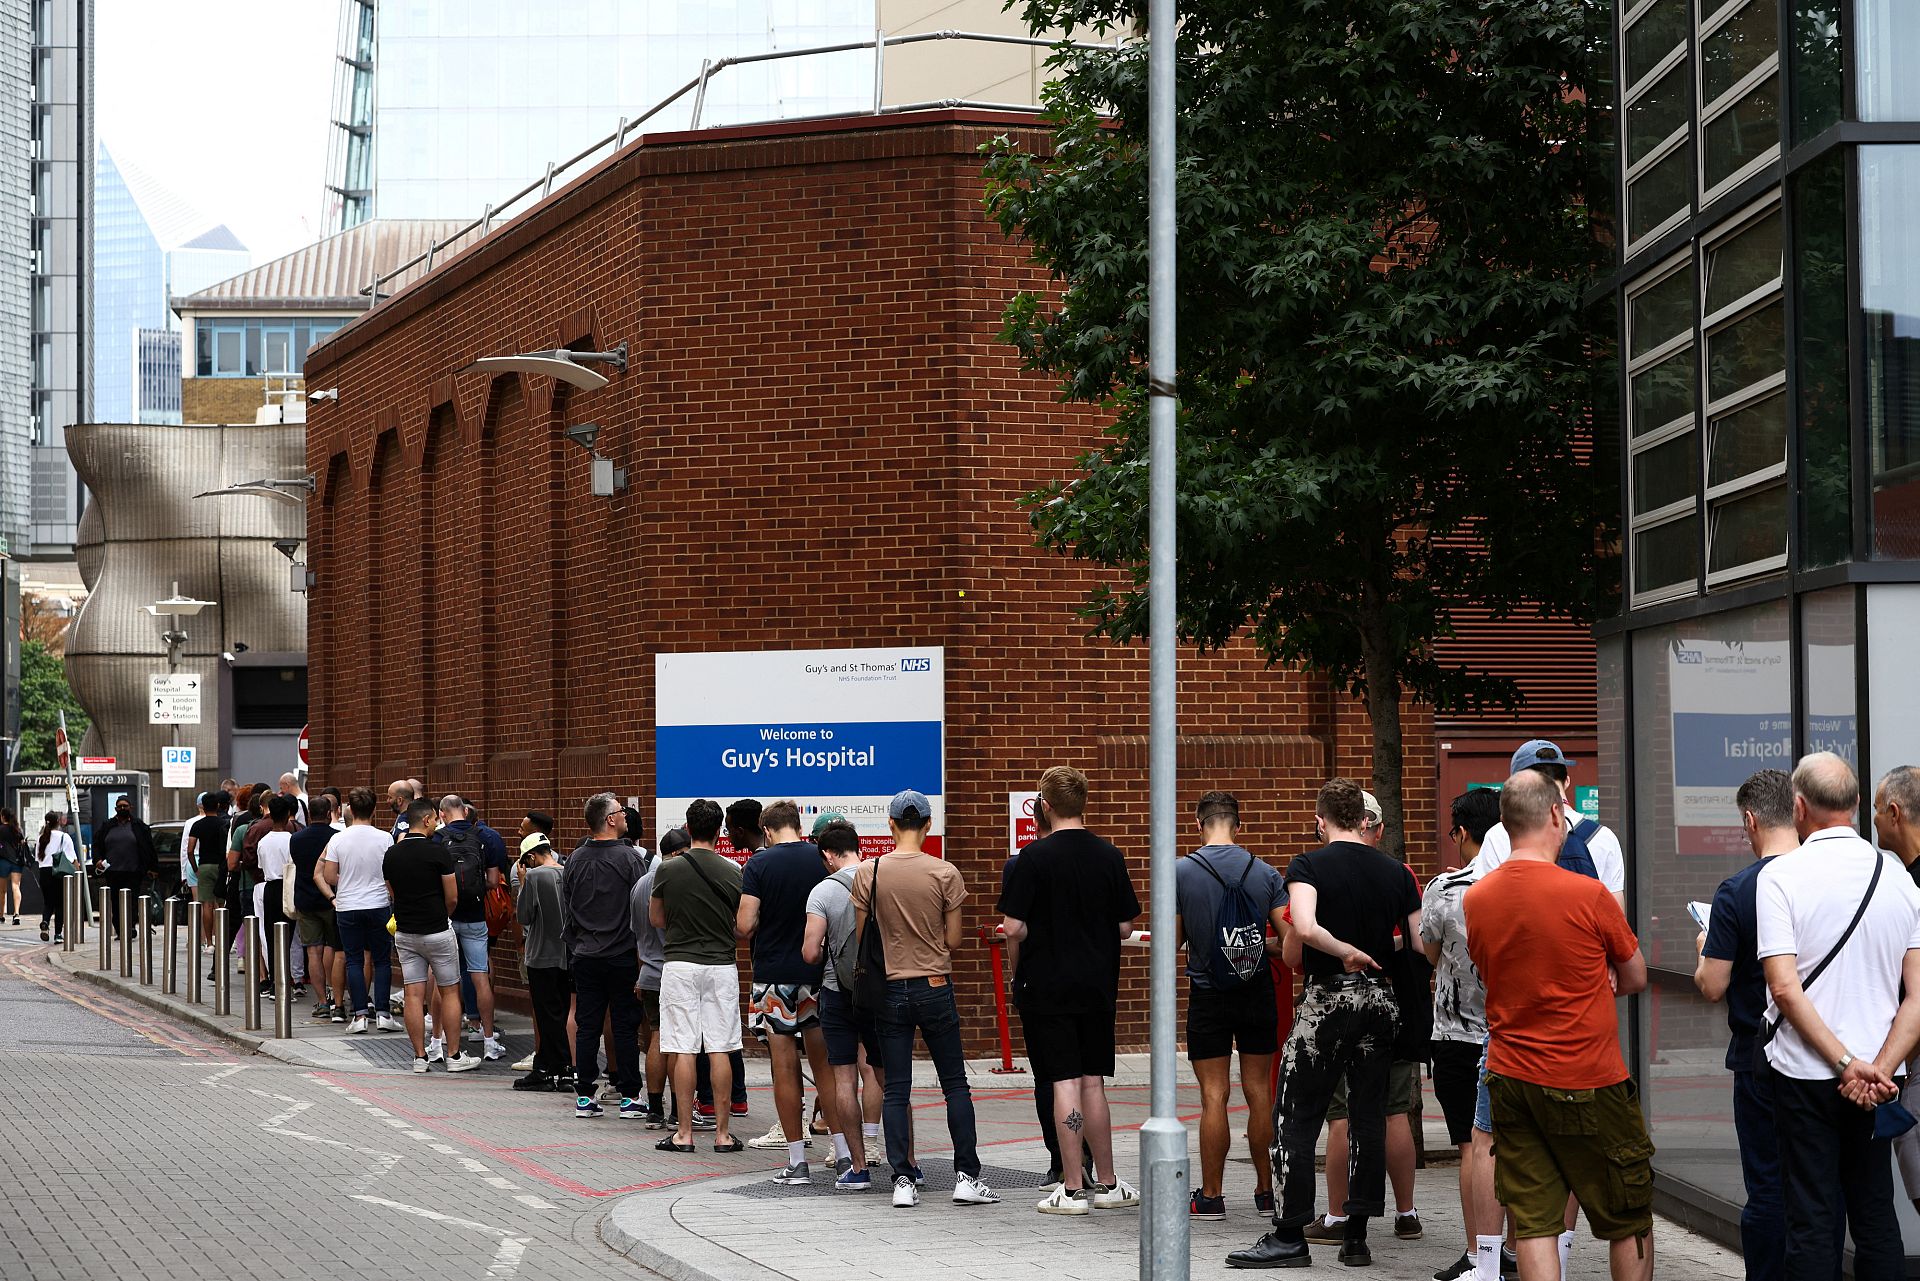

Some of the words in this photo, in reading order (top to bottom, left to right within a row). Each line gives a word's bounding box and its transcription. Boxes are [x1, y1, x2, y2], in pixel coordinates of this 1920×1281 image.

[805, 664, 828, 675] Guy's
[830, 664, 847, 673] and
[849, 663, 858, 672] St
[860, 662, 897, 672] Thomas'
[901, 659, 929, 671] NHS
[153, 678, 171, 686] Guy's
[759, 728, 816, 740] Welcome
[820, 729, 834, 740] to
[721, 748, 779, 772] Guy's
[786, 745, 875, 772] Hospital
[34, 775, 62, 785] main
[1582, 799, 1599, 808] ESC
[820, 805, 848, 814] KING'S
[850, 804, 885, 814] HEALTH
[872, 837, 896, 846] hospita
[1018, 833, 1038, 842] parki
[721, 846, 735, 854] A&E
[861, 846, 881, 854] Road,
